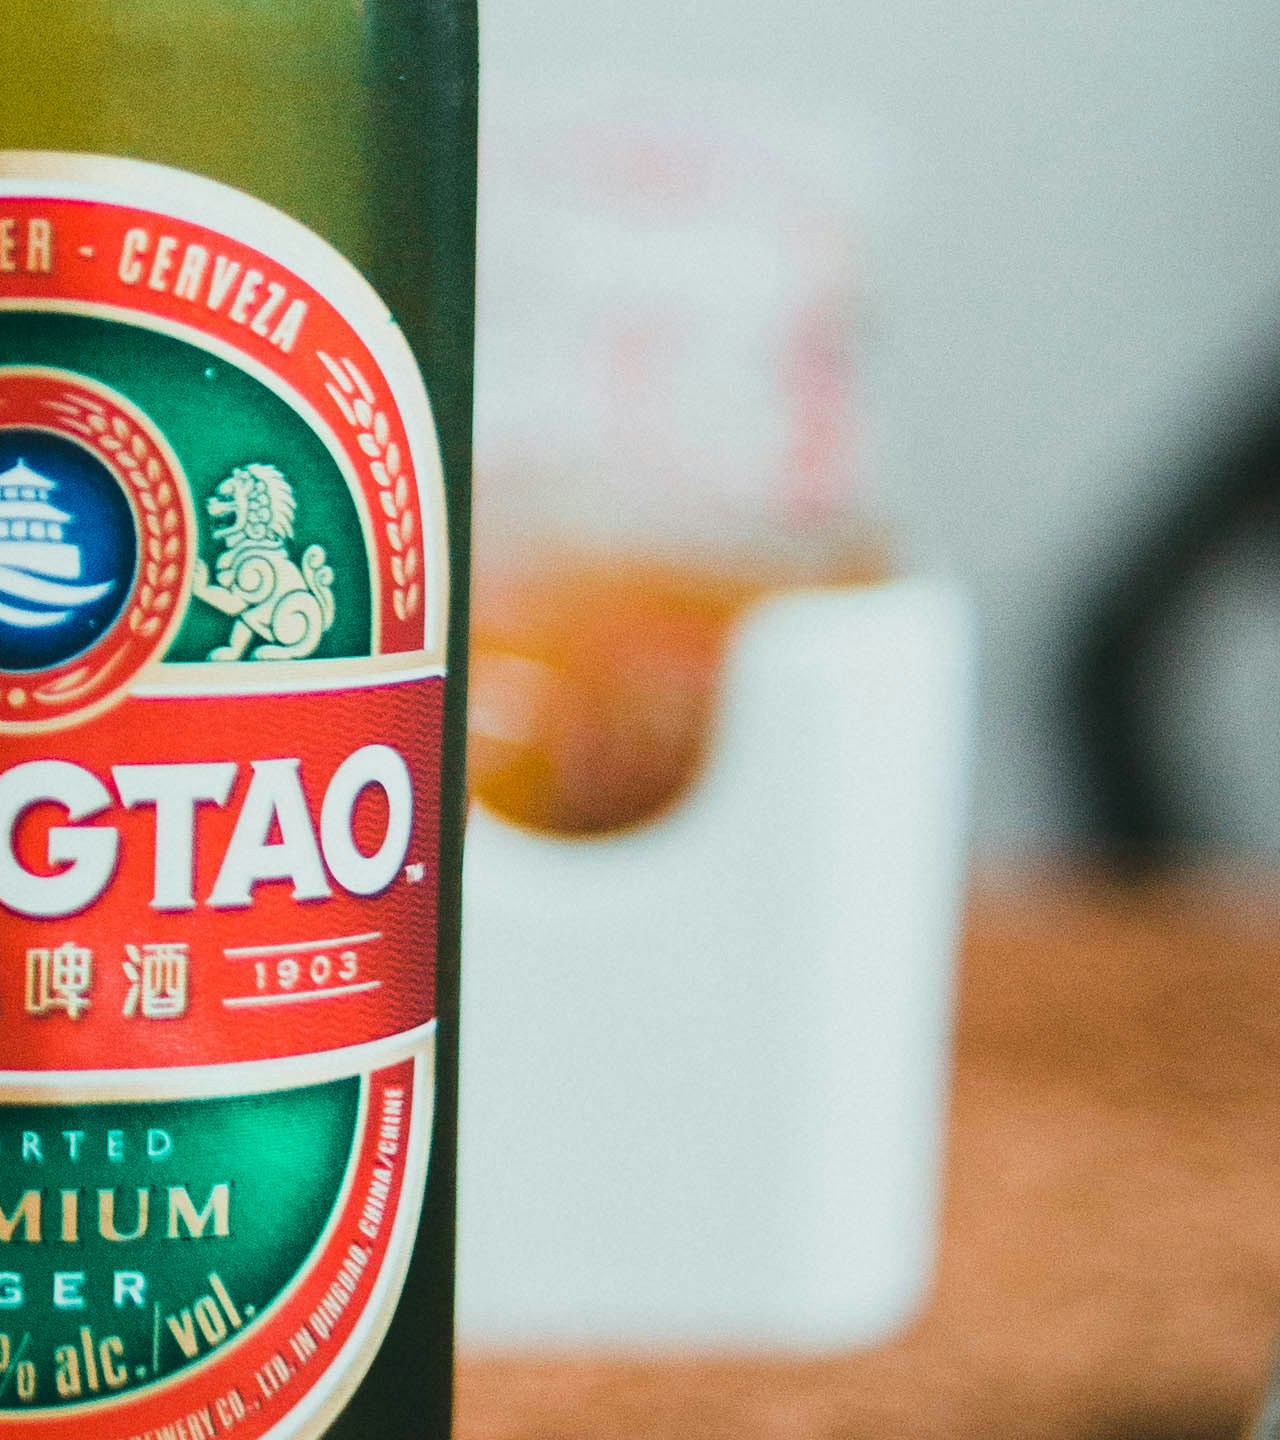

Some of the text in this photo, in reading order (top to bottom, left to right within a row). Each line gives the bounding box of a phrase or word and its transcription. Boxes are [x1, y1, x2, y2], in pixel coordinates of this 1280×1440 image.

[117, 227, 308, 354] CERVEZA
[252, 949, 361, 988] 1903
[290, 1322, 319, 1366] IN
